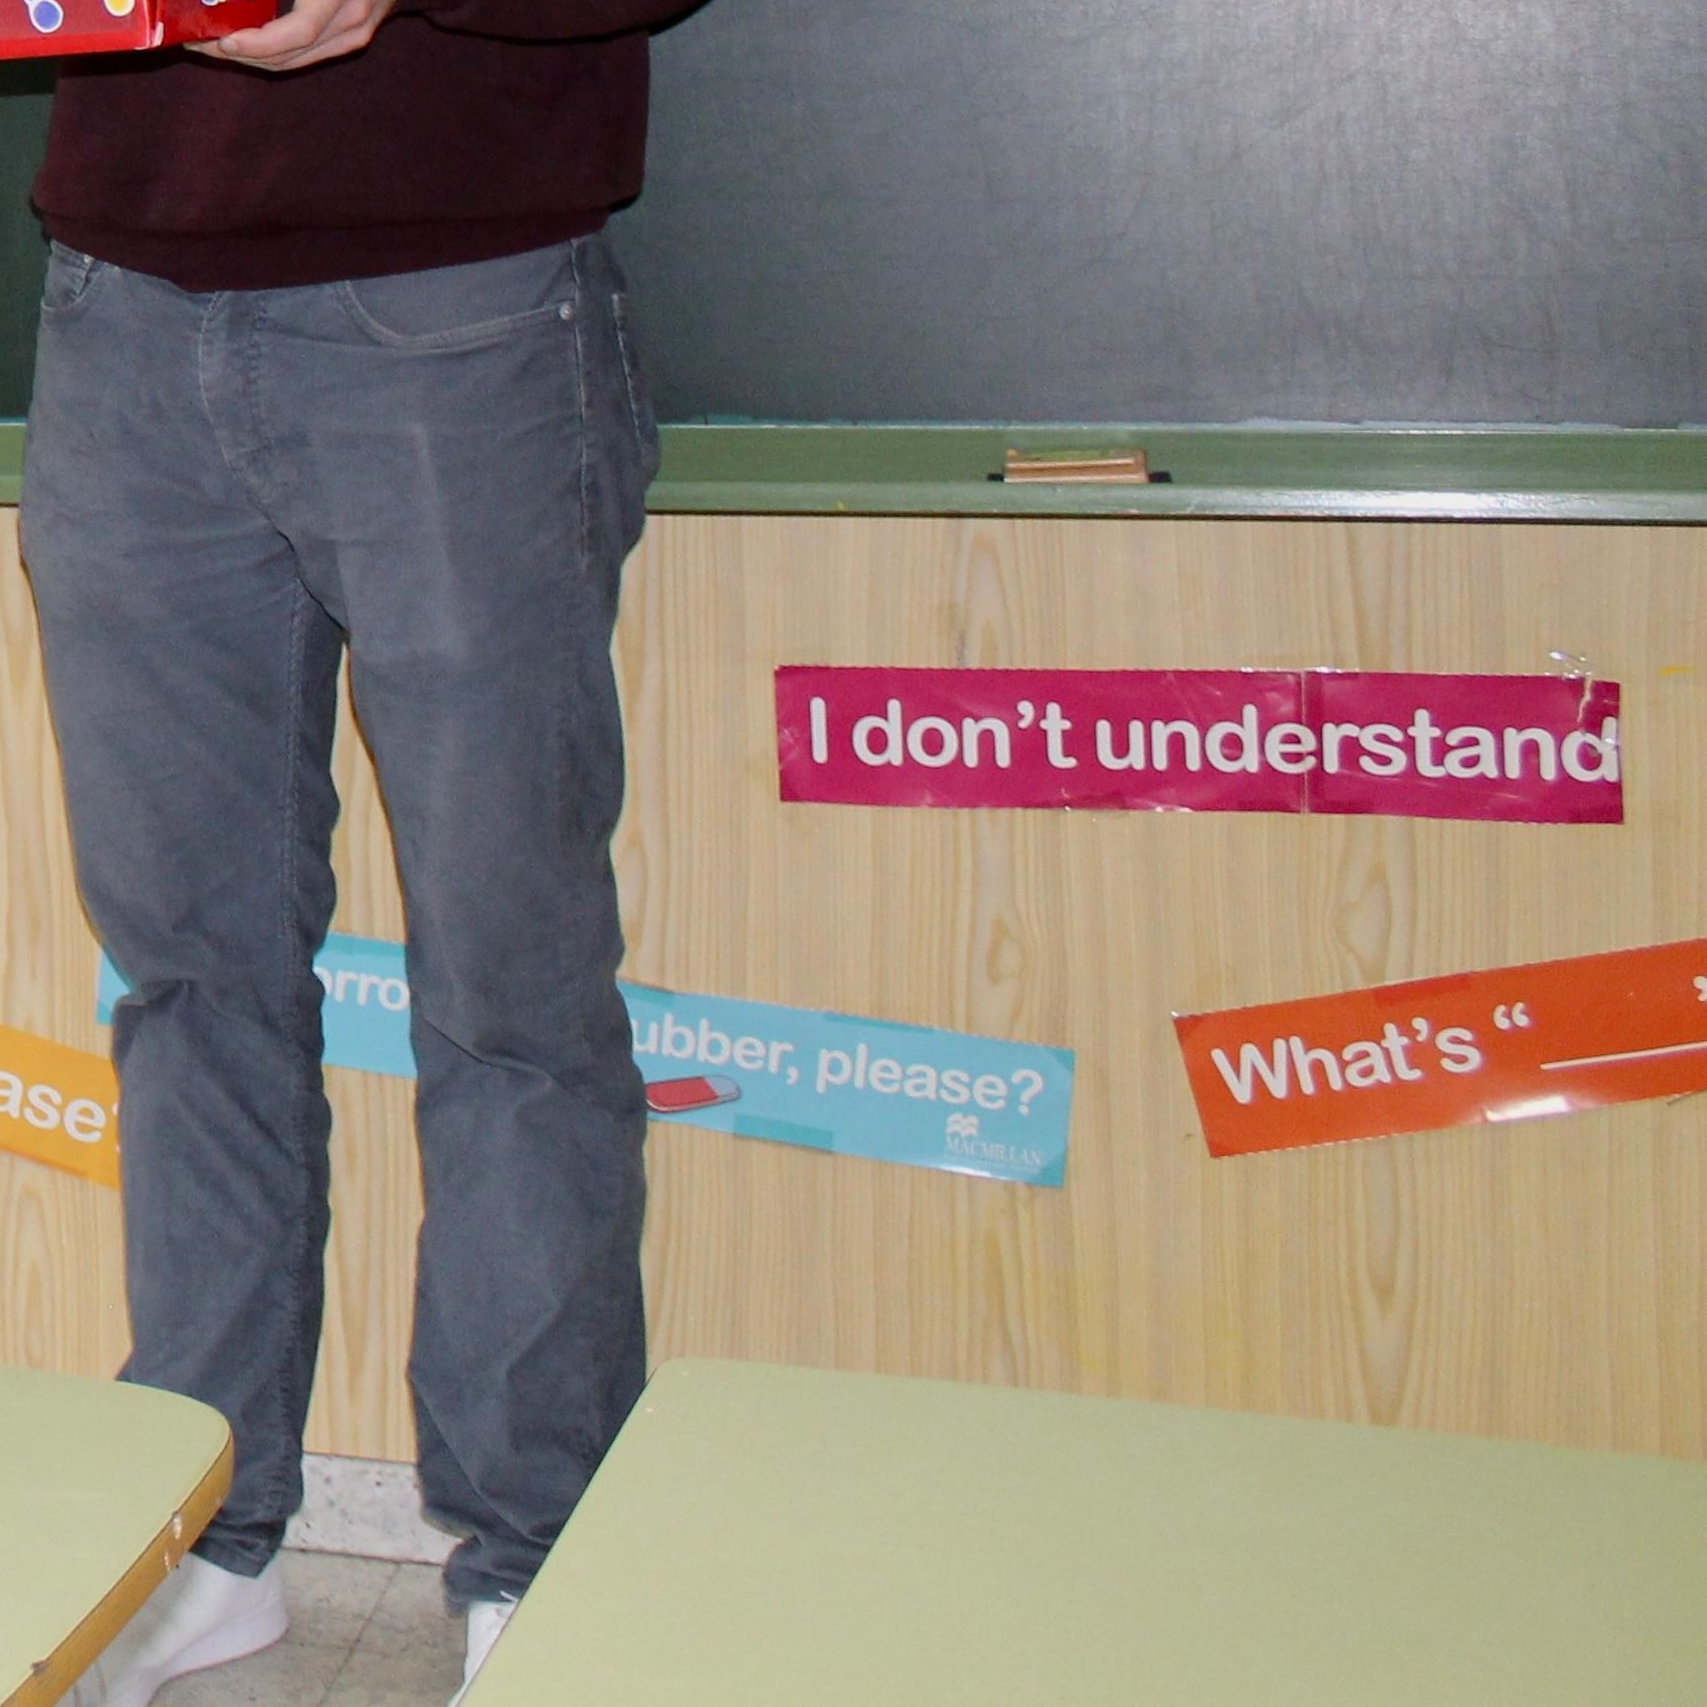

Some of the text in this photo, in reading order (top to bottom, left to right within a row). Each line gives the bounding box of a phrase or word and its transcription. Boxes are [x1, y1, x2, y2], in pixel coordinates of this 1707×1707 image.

[809, 696, 828, 765] I
[1094, 704, 1621, 784] understand
[632, 1008, 800, 1084] ubber,
[816, 1036, 1044, 1117] please?
